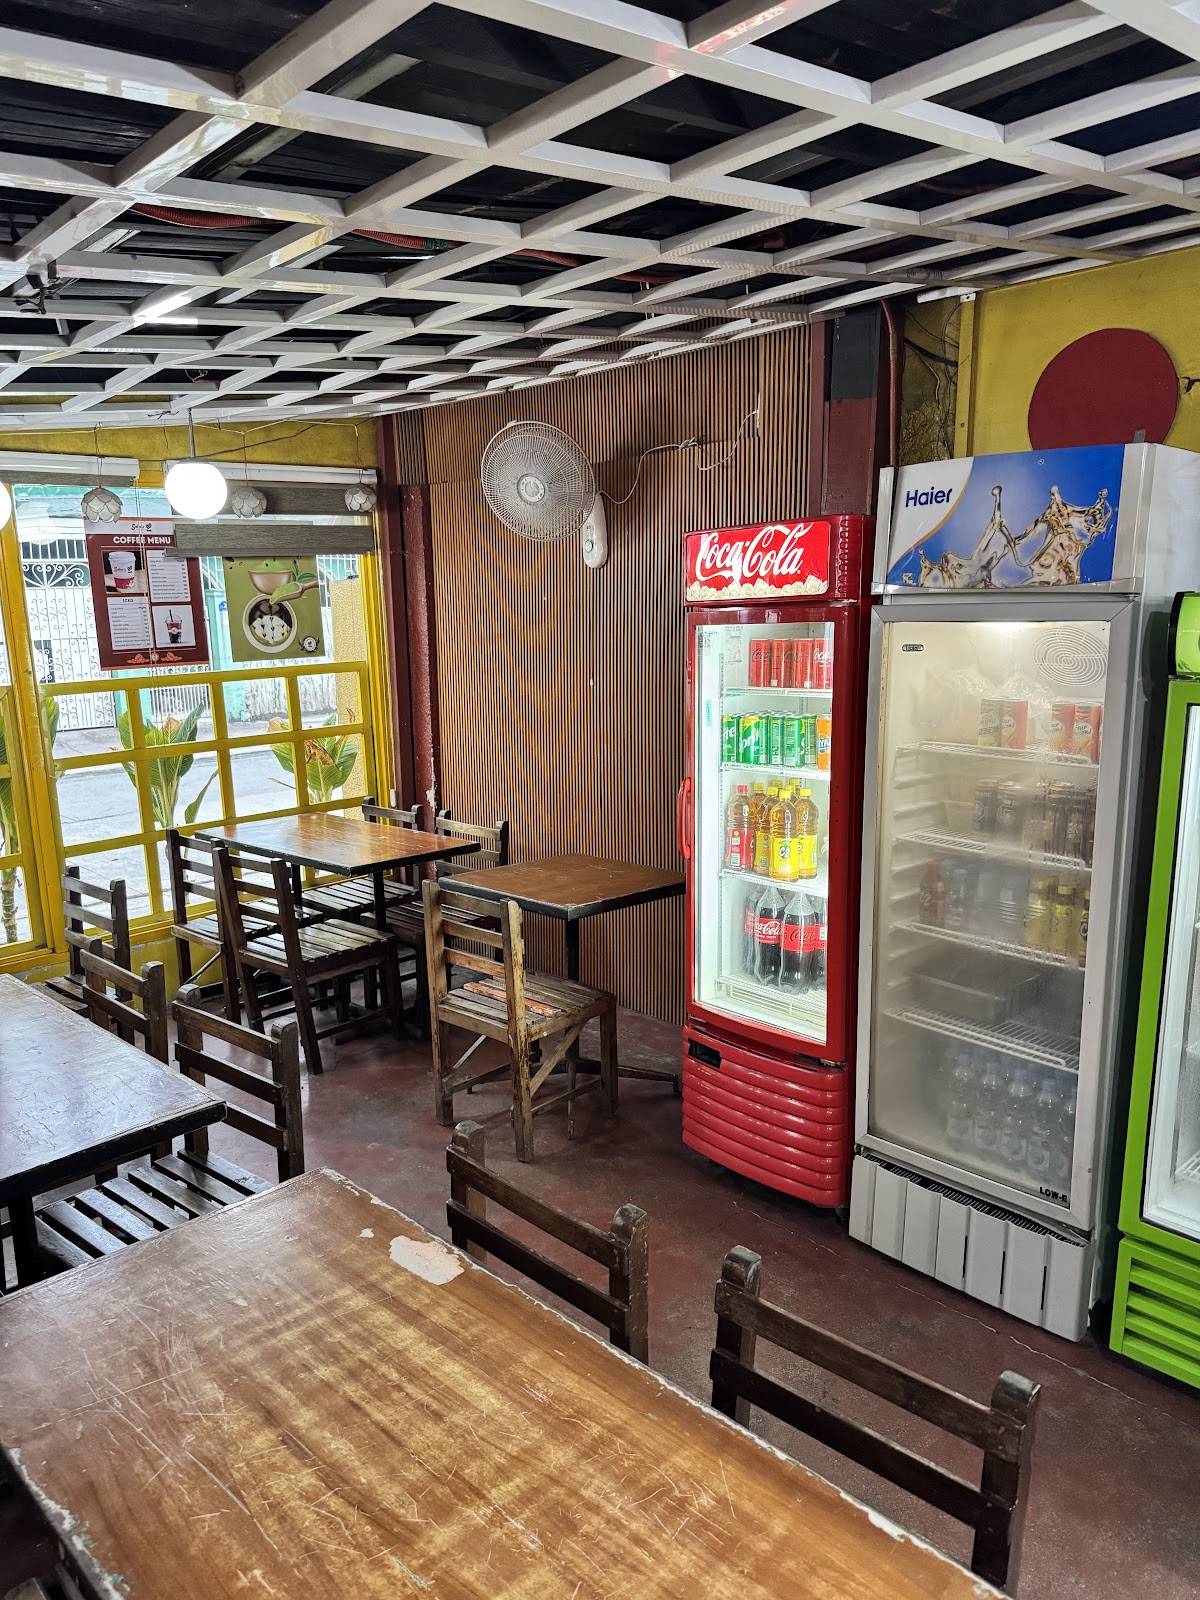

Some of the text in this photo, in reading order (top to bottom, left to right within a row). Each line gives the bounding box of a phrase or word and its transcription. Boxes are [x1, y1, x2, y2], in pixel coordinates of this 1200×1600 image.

[905, 486, 953, 507] Haier
[113, 536, 145, 544] COFFEE
[695, 521, 814, 581] Coca-Cola
[1039, 1186, 1068, 1202] LOW-E
